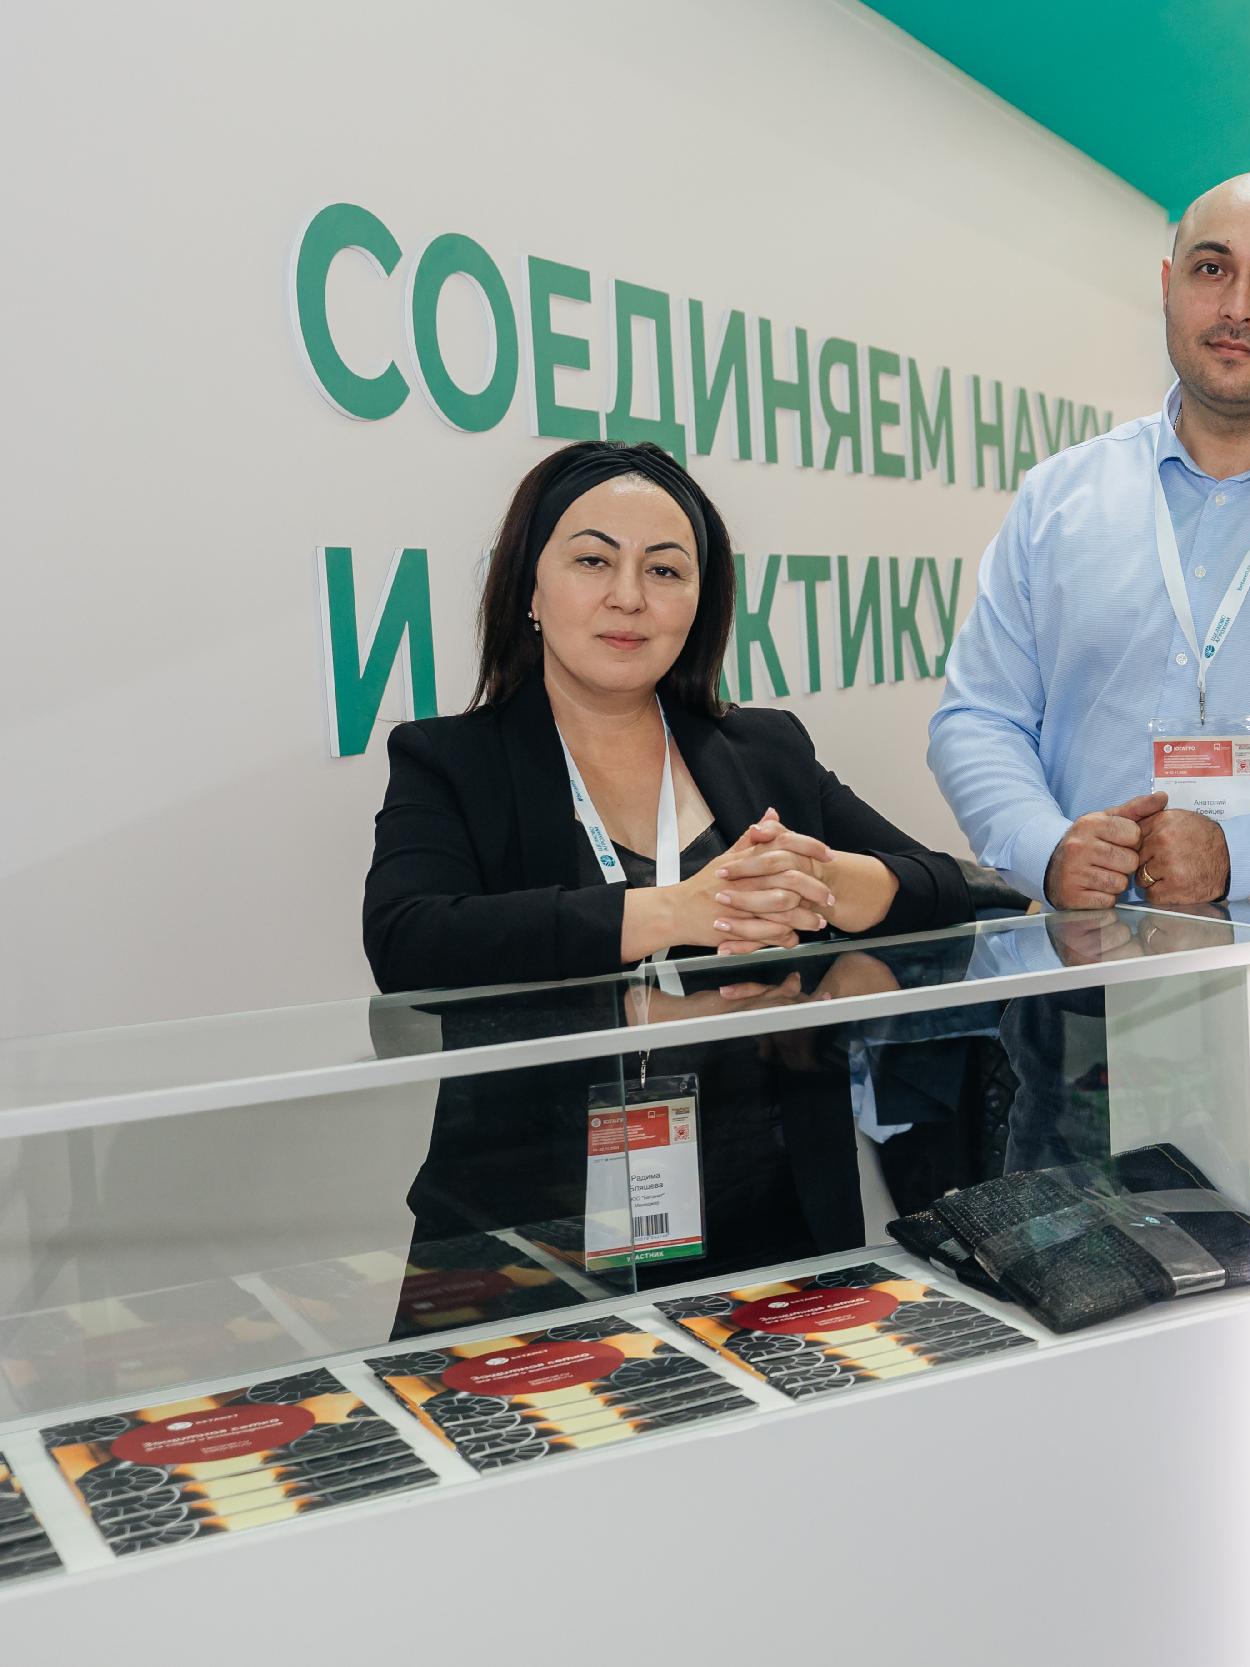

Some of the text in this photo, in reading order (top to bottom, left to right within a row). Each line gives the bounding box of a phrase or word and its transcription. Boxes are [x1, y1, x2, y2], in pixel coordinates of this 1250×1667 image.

[293, 202, 956, 485] СОЕДИНЯЕМ
[317, 547, 438, 757] И
[719, 552, 963, 704] КТИКУ
[626, 1251, 665, 1262] УАСТНИК
